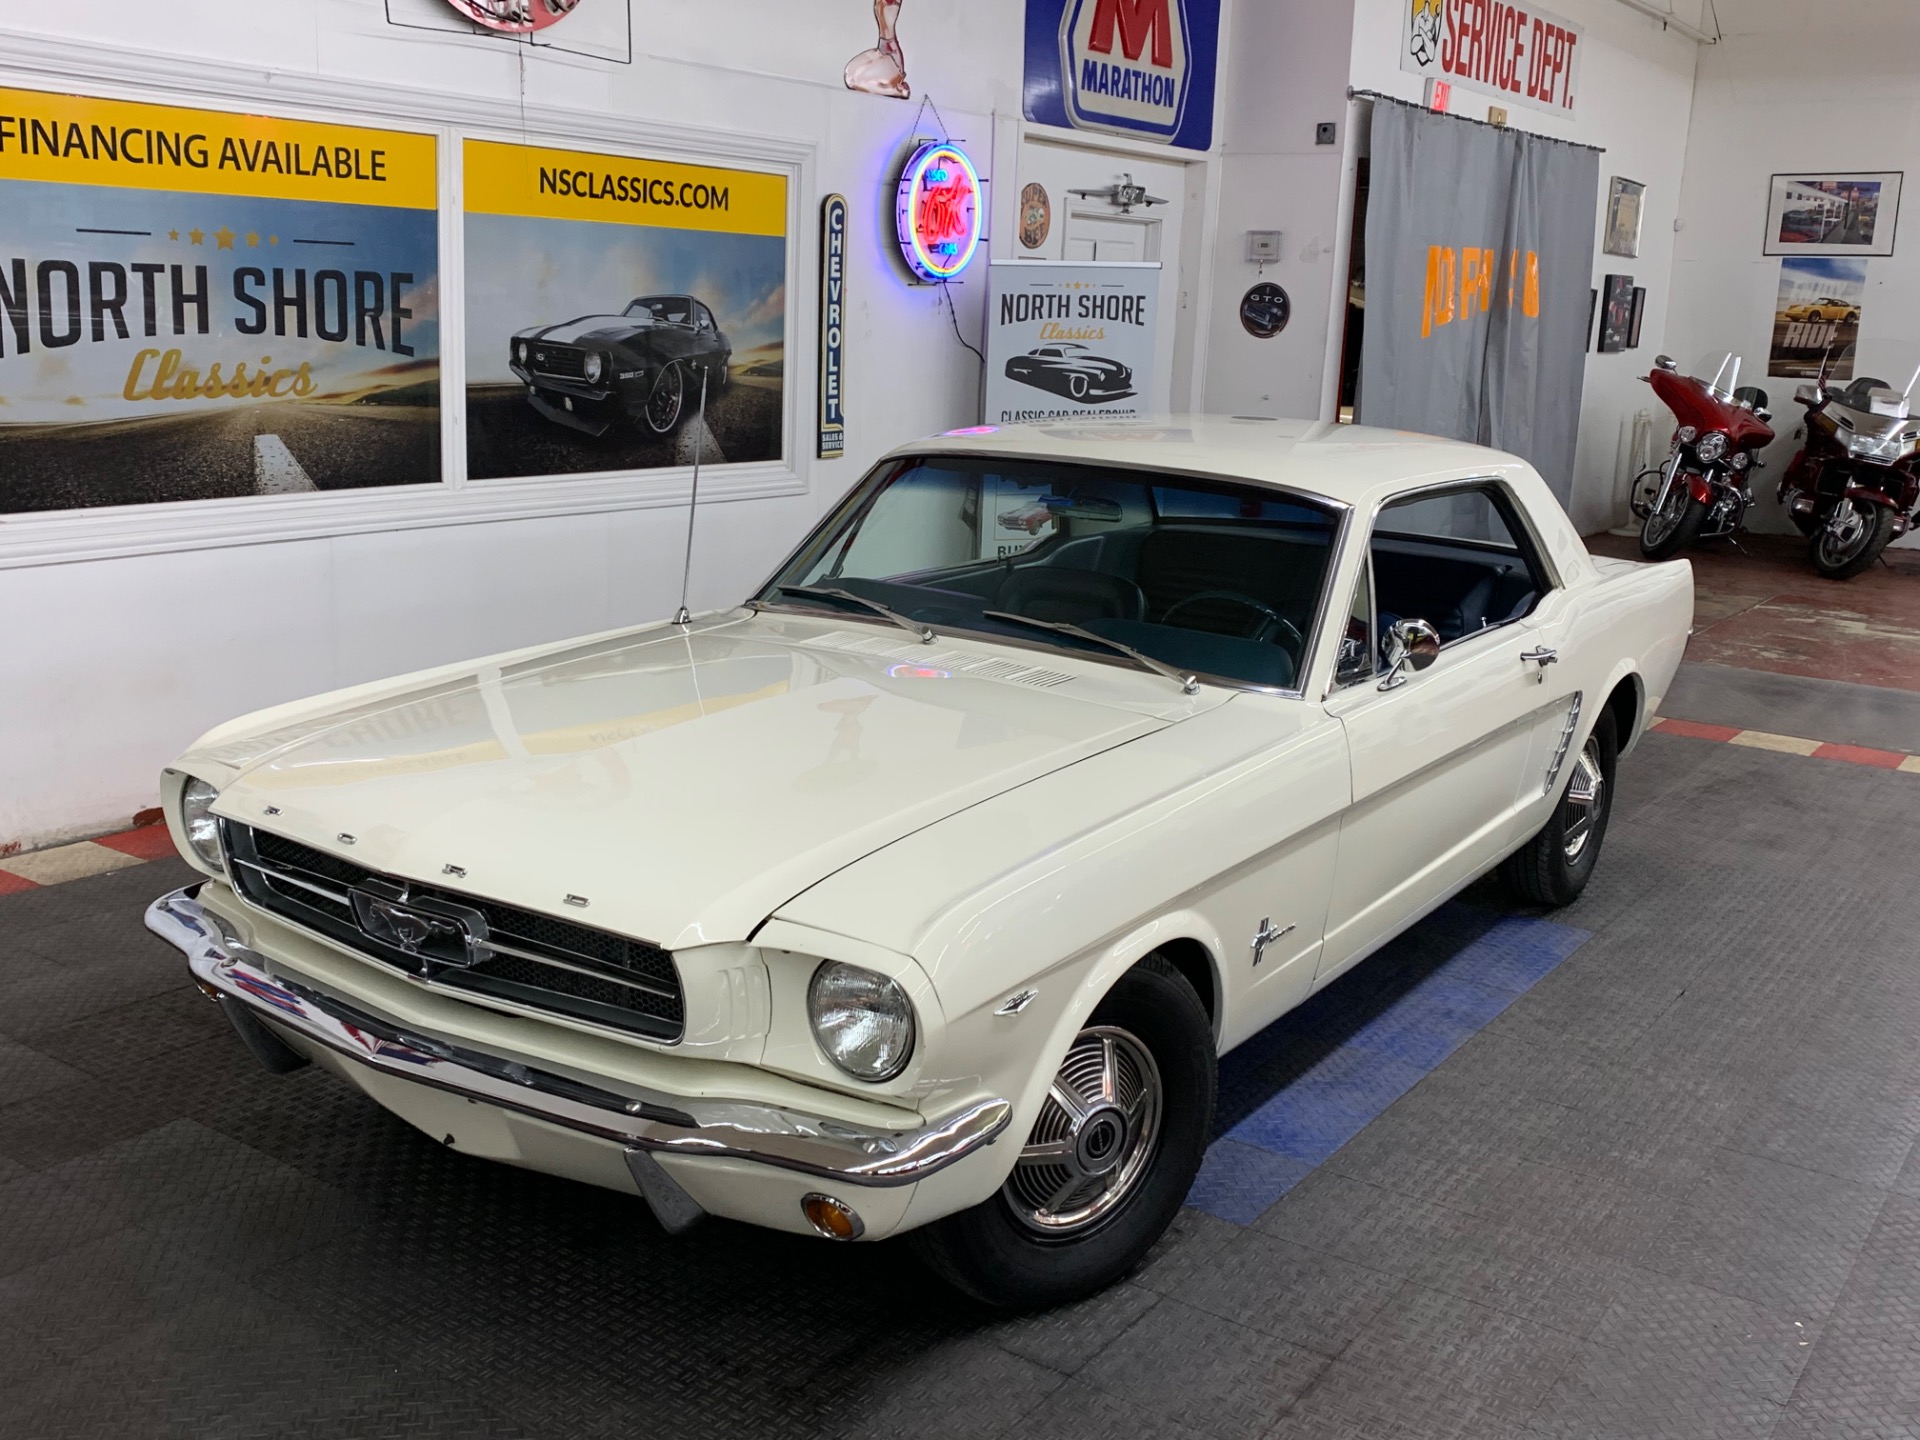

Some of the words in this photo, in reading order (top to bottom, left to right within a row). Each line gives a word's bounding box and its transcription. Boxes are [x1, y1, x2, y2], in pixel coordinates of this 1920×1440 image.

[1088, 0, 1172, 69] M
[1442, 0, 1528, 93] SERVICE
[1527, 18, 1577, 109] DEPT.
[1081, 59, 1175, 108] MARATHON
[0, 116, 209, 168] FINANCING
[218, 137, 386, 182] AVAILABLE
[539, 167, 729, 211] NSCLASSICS.COM
[0, 258, 209, 358] NORTH
[233, 266, 414, 357] SHORE
[828, 208, 843, 419] CHEVROLET
[1001, 294, 1071, 326] NORTH
[1078, 295, 1146, 326] SHORE
[1250, 294, 1283, 304] GTO
[1039, 322, 1106, 340] Classics
[1783, 322, 1838, 349] RIDE
[123, 348, 317, 401] Classics
[822, 433, 839, 442] SALES
